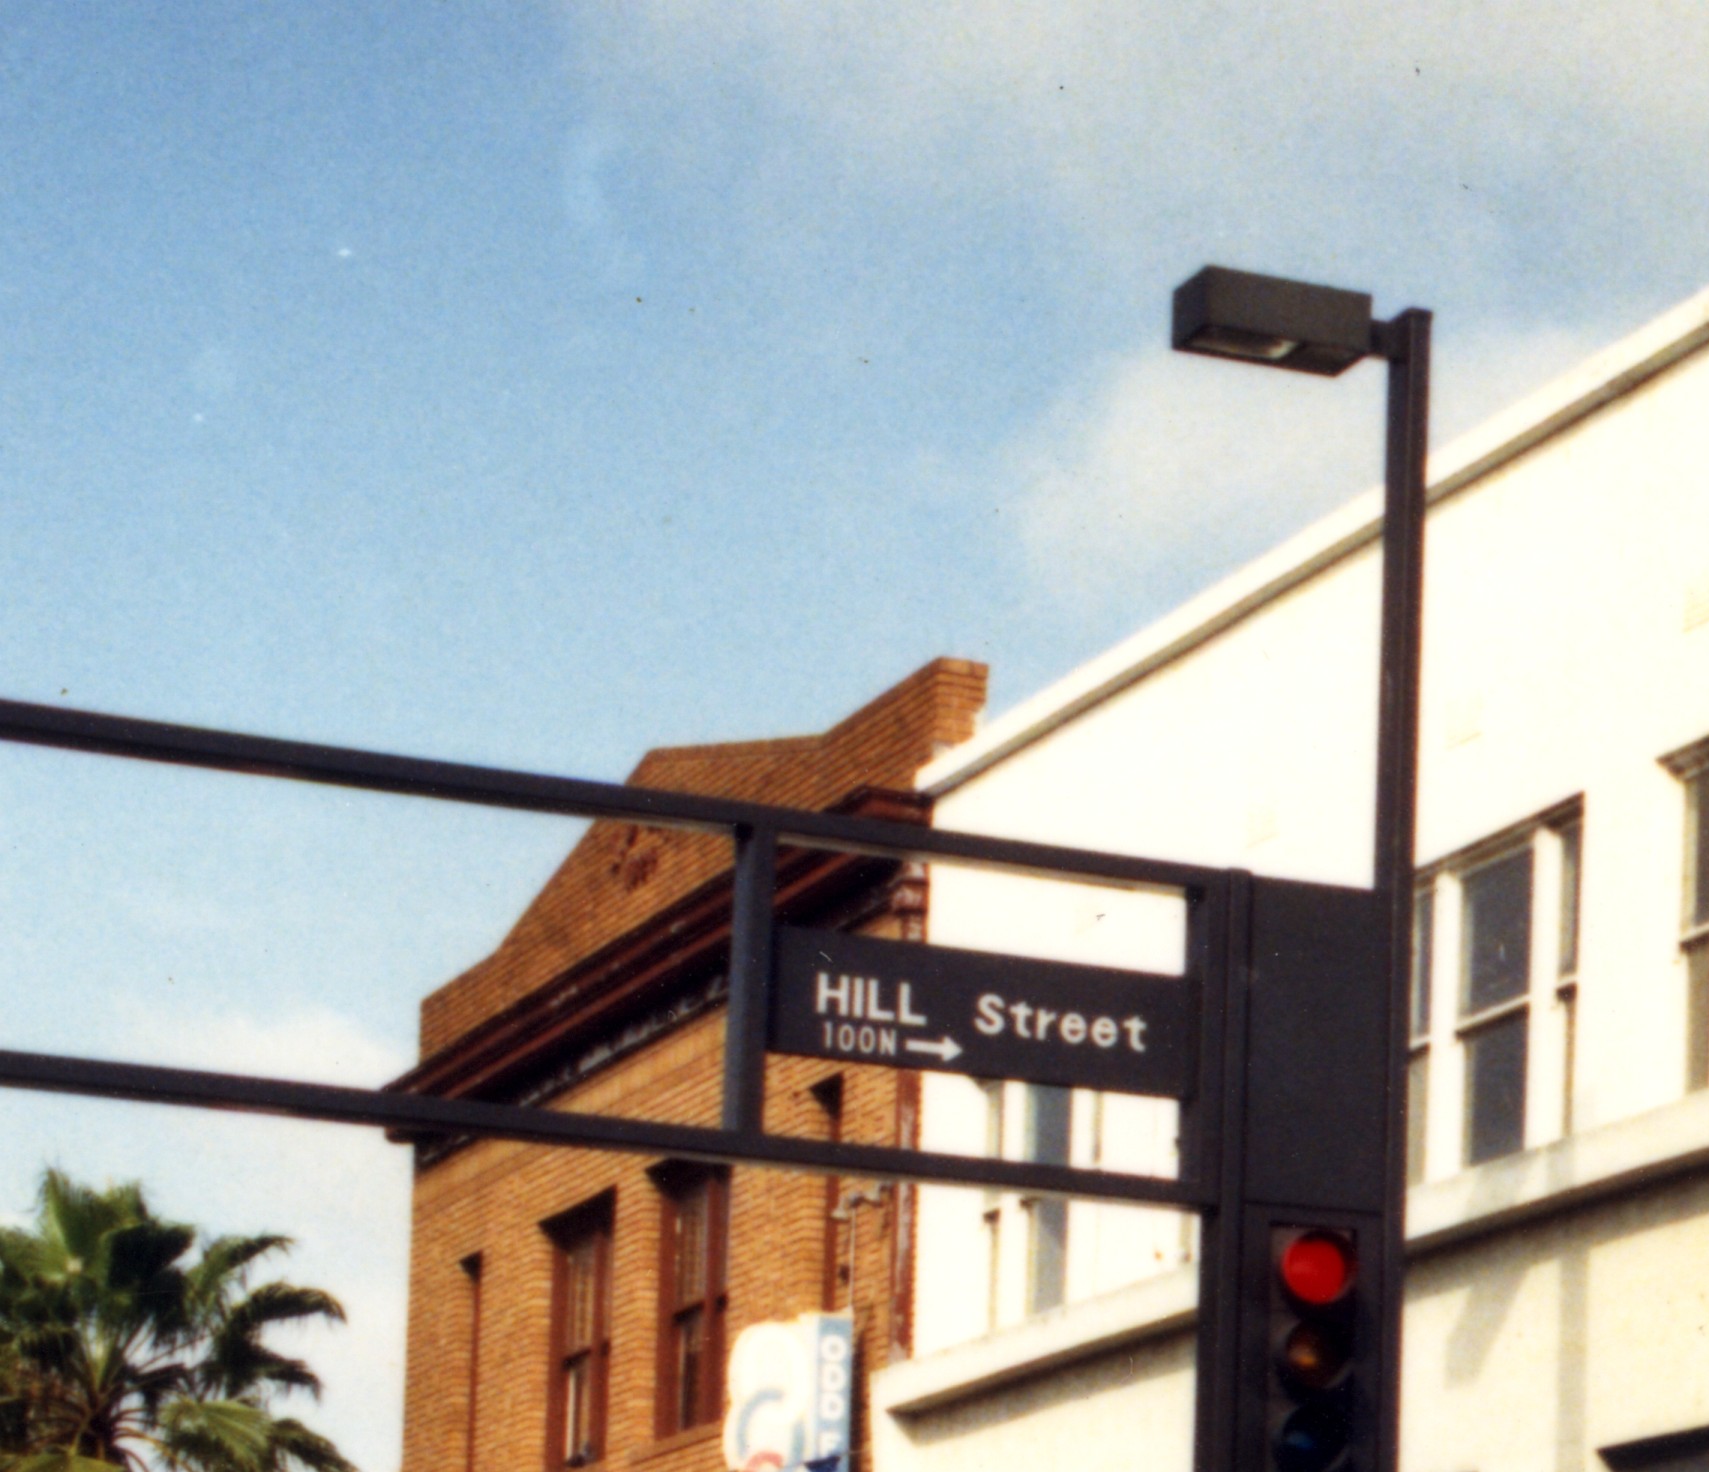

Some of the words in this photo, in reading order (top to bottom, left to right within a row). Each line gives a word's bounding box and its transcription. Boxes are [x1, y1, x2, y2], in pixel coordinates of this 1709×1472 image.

[815, 971, 927, 1027] HILL
[973, 994, 1148, 1053] Street
[821, 1020, 897, 1057] 100N
[819, 1334, 847, 1421] ODD
